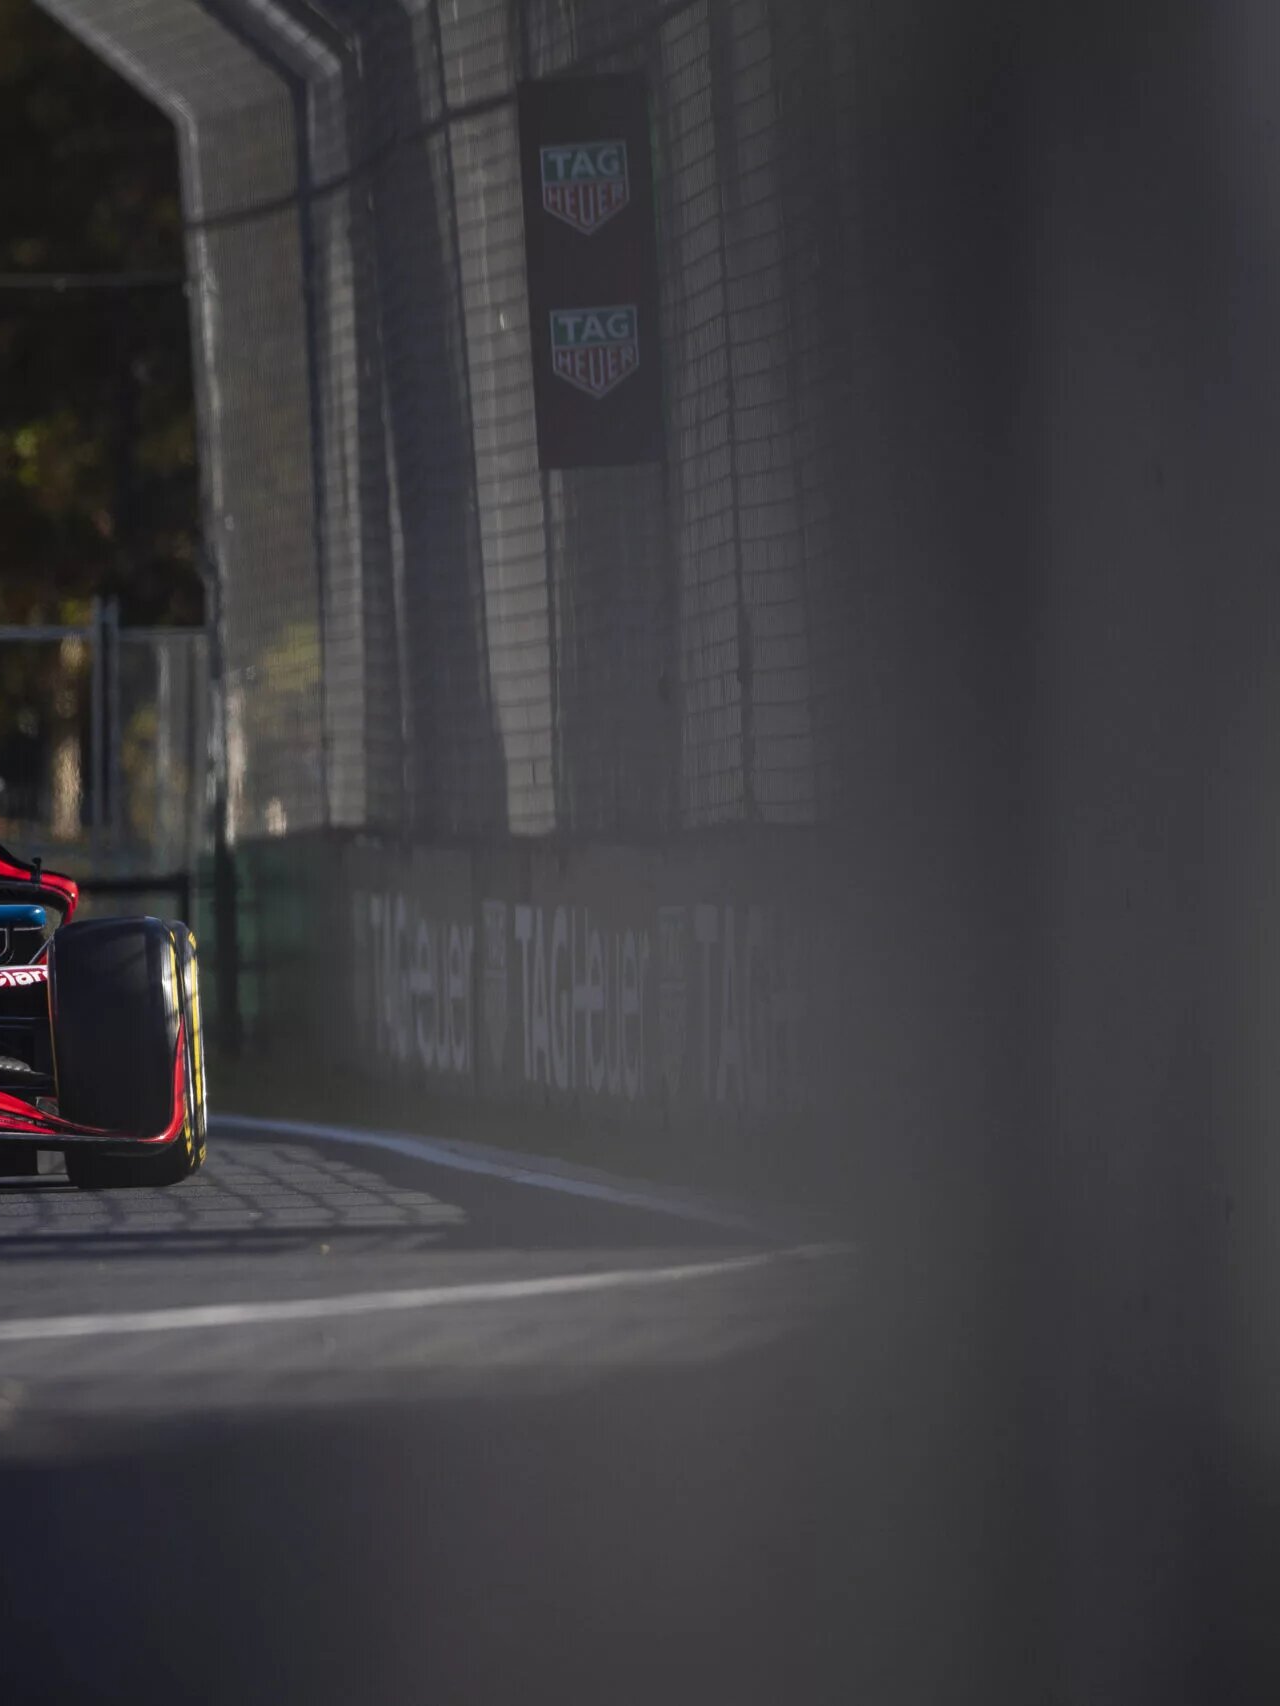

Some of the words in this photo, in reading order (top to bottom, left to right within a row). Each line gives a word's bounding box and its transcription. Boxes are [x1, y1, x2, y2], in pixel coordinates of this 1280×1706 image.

[547, 147, 620, 180] TAG
[547, 182, 624, 226] HEUER
[557, 313, 630, 344] TAG
[557, 346, 634, 391] HEUER
